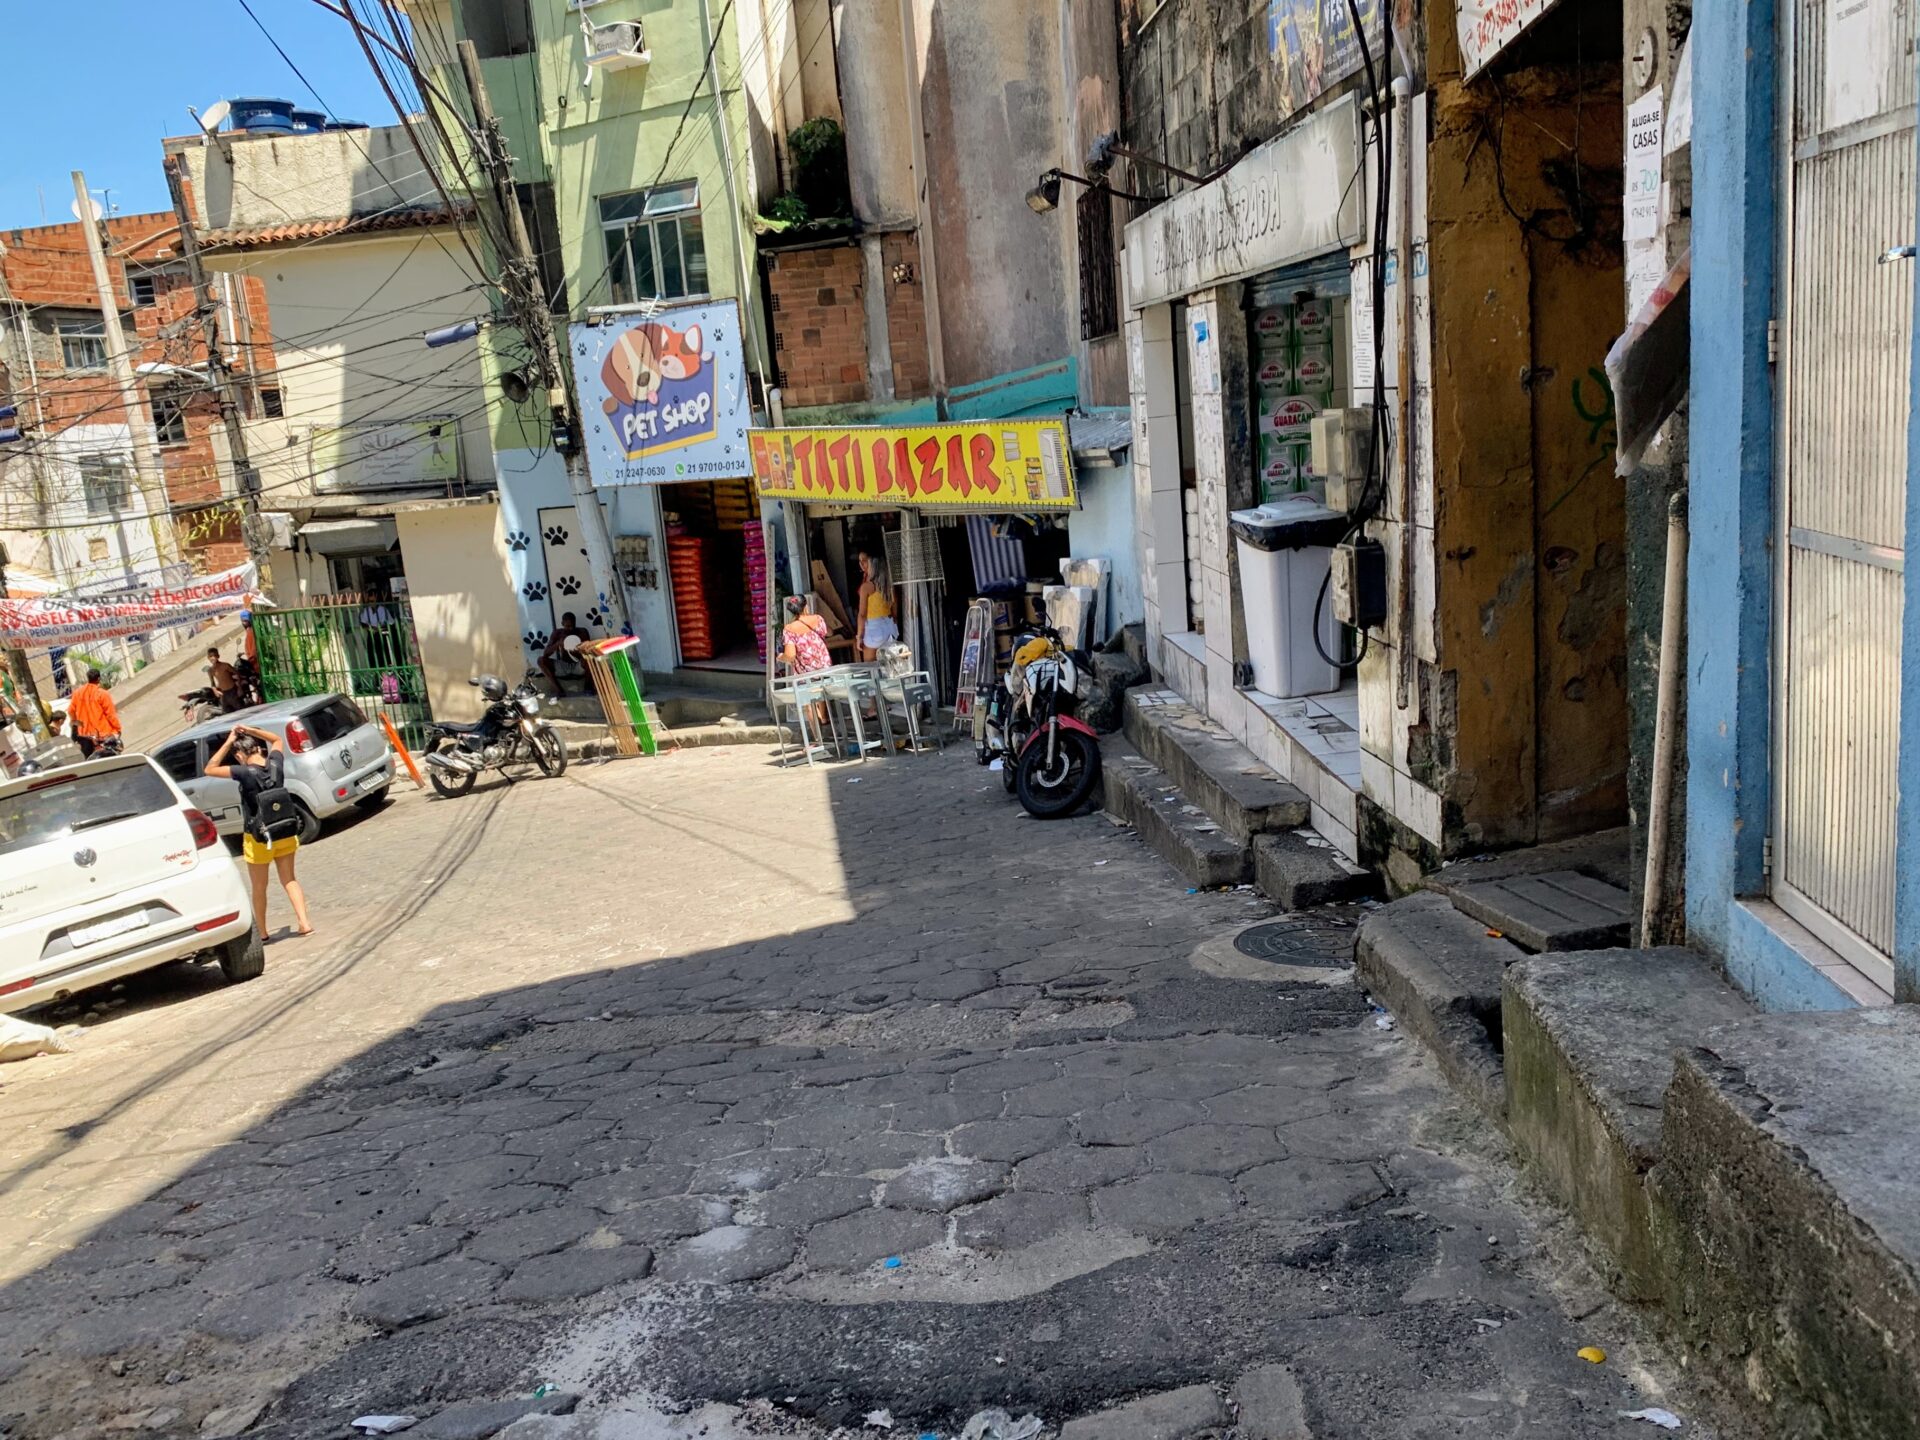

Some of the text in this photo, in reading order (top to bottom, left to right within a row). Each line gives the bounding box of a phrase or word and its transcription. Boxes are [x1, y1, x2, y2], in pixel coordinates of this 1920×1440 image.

[1632, 111, 1660, 128] ALUGA-SE
[1633, 129, 1658, 149] CASAS
[622, 391, 711, 446] PET SHOP
[615, 460, 746, 478] 21 2247-0630 21 97010-0134
[794, 433, 1001, 498] TATI BAZAR
[26, 608, 74, 627] GISELE
[30, 626, 60, 638] PEDRO
[63, 618, 121, 634] RODRIGUES
